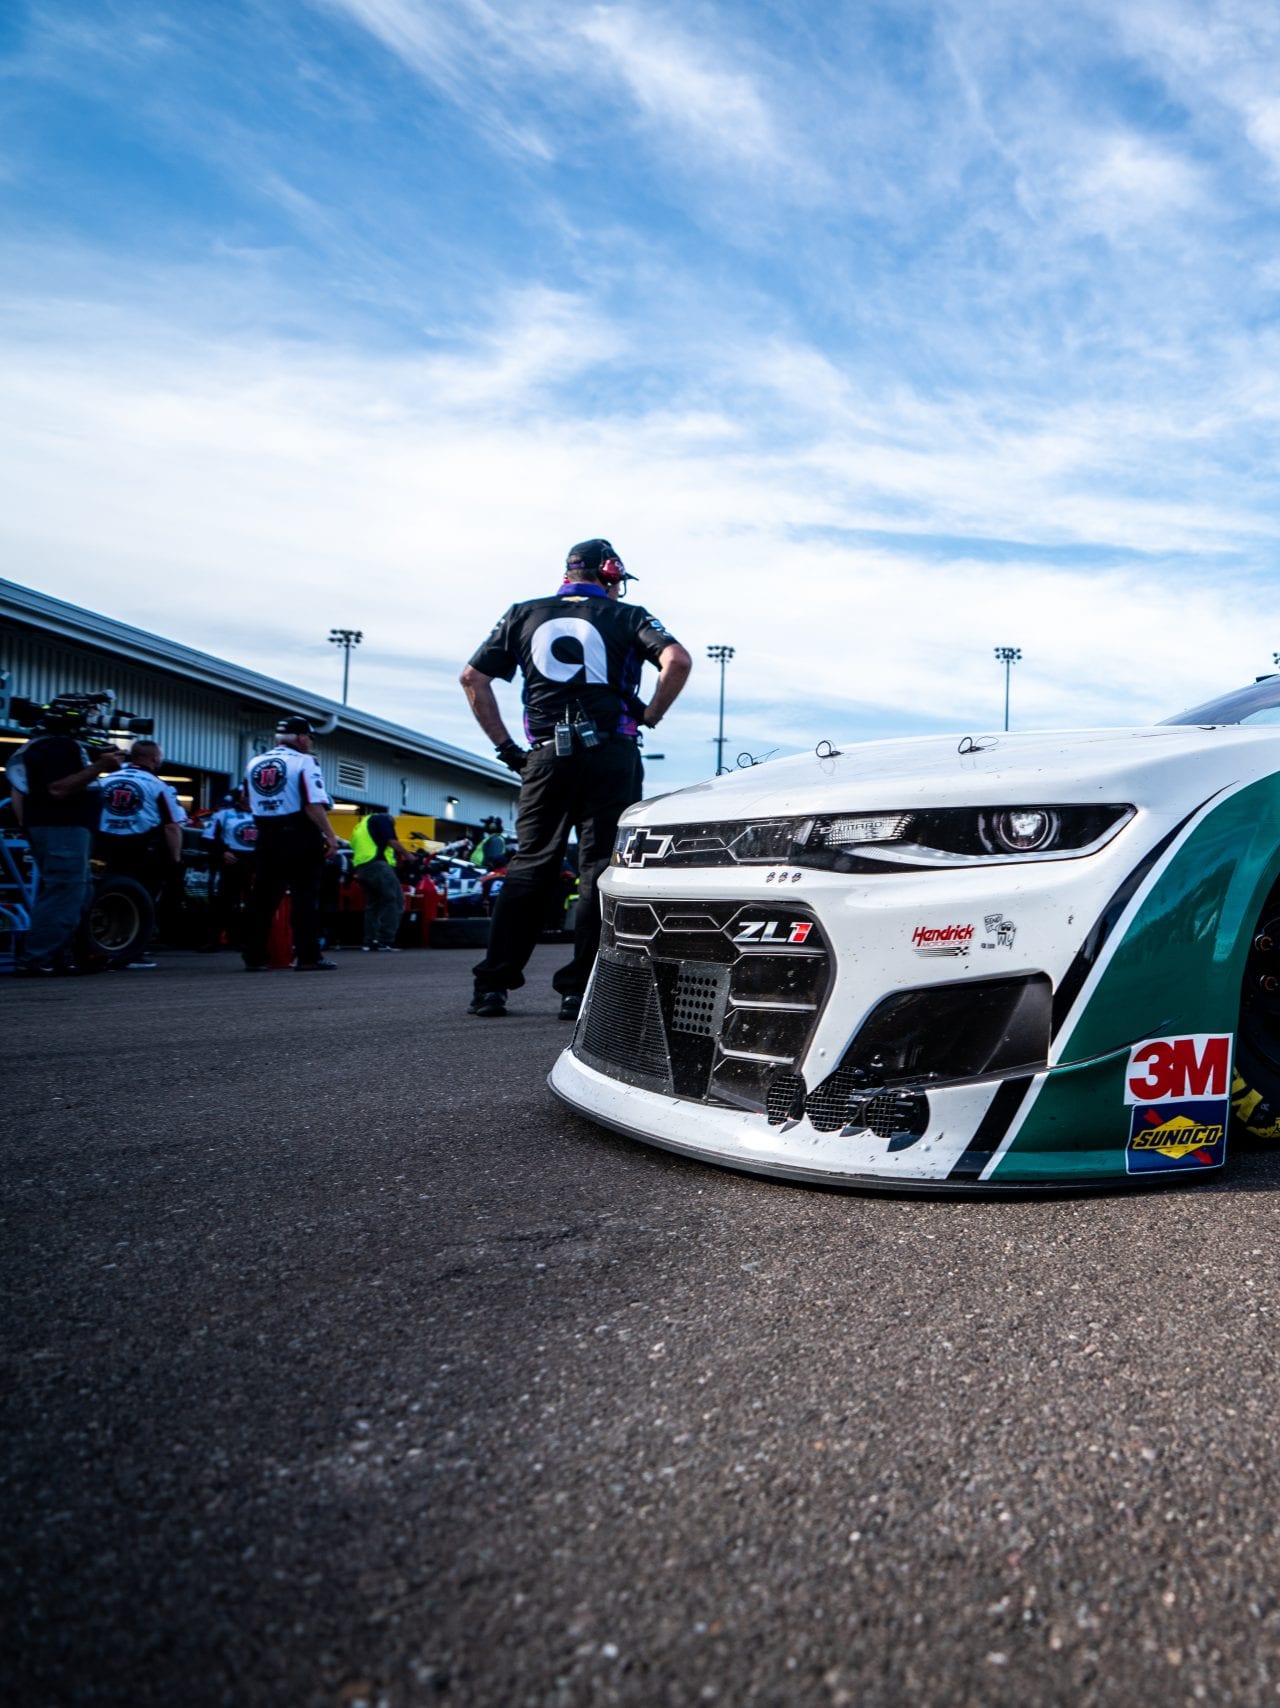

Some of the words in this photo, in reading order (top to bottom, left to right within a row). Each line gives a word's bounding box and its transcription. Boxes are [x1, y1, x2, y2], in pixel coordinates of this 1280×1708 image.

[732, 921, 814, 944] ZL1
[911, 923, 975, 948] Hendrick
[1129, 1038, 1230, 1100] 3M
[1133, 1125, 1222, 1149] SUNOCO
